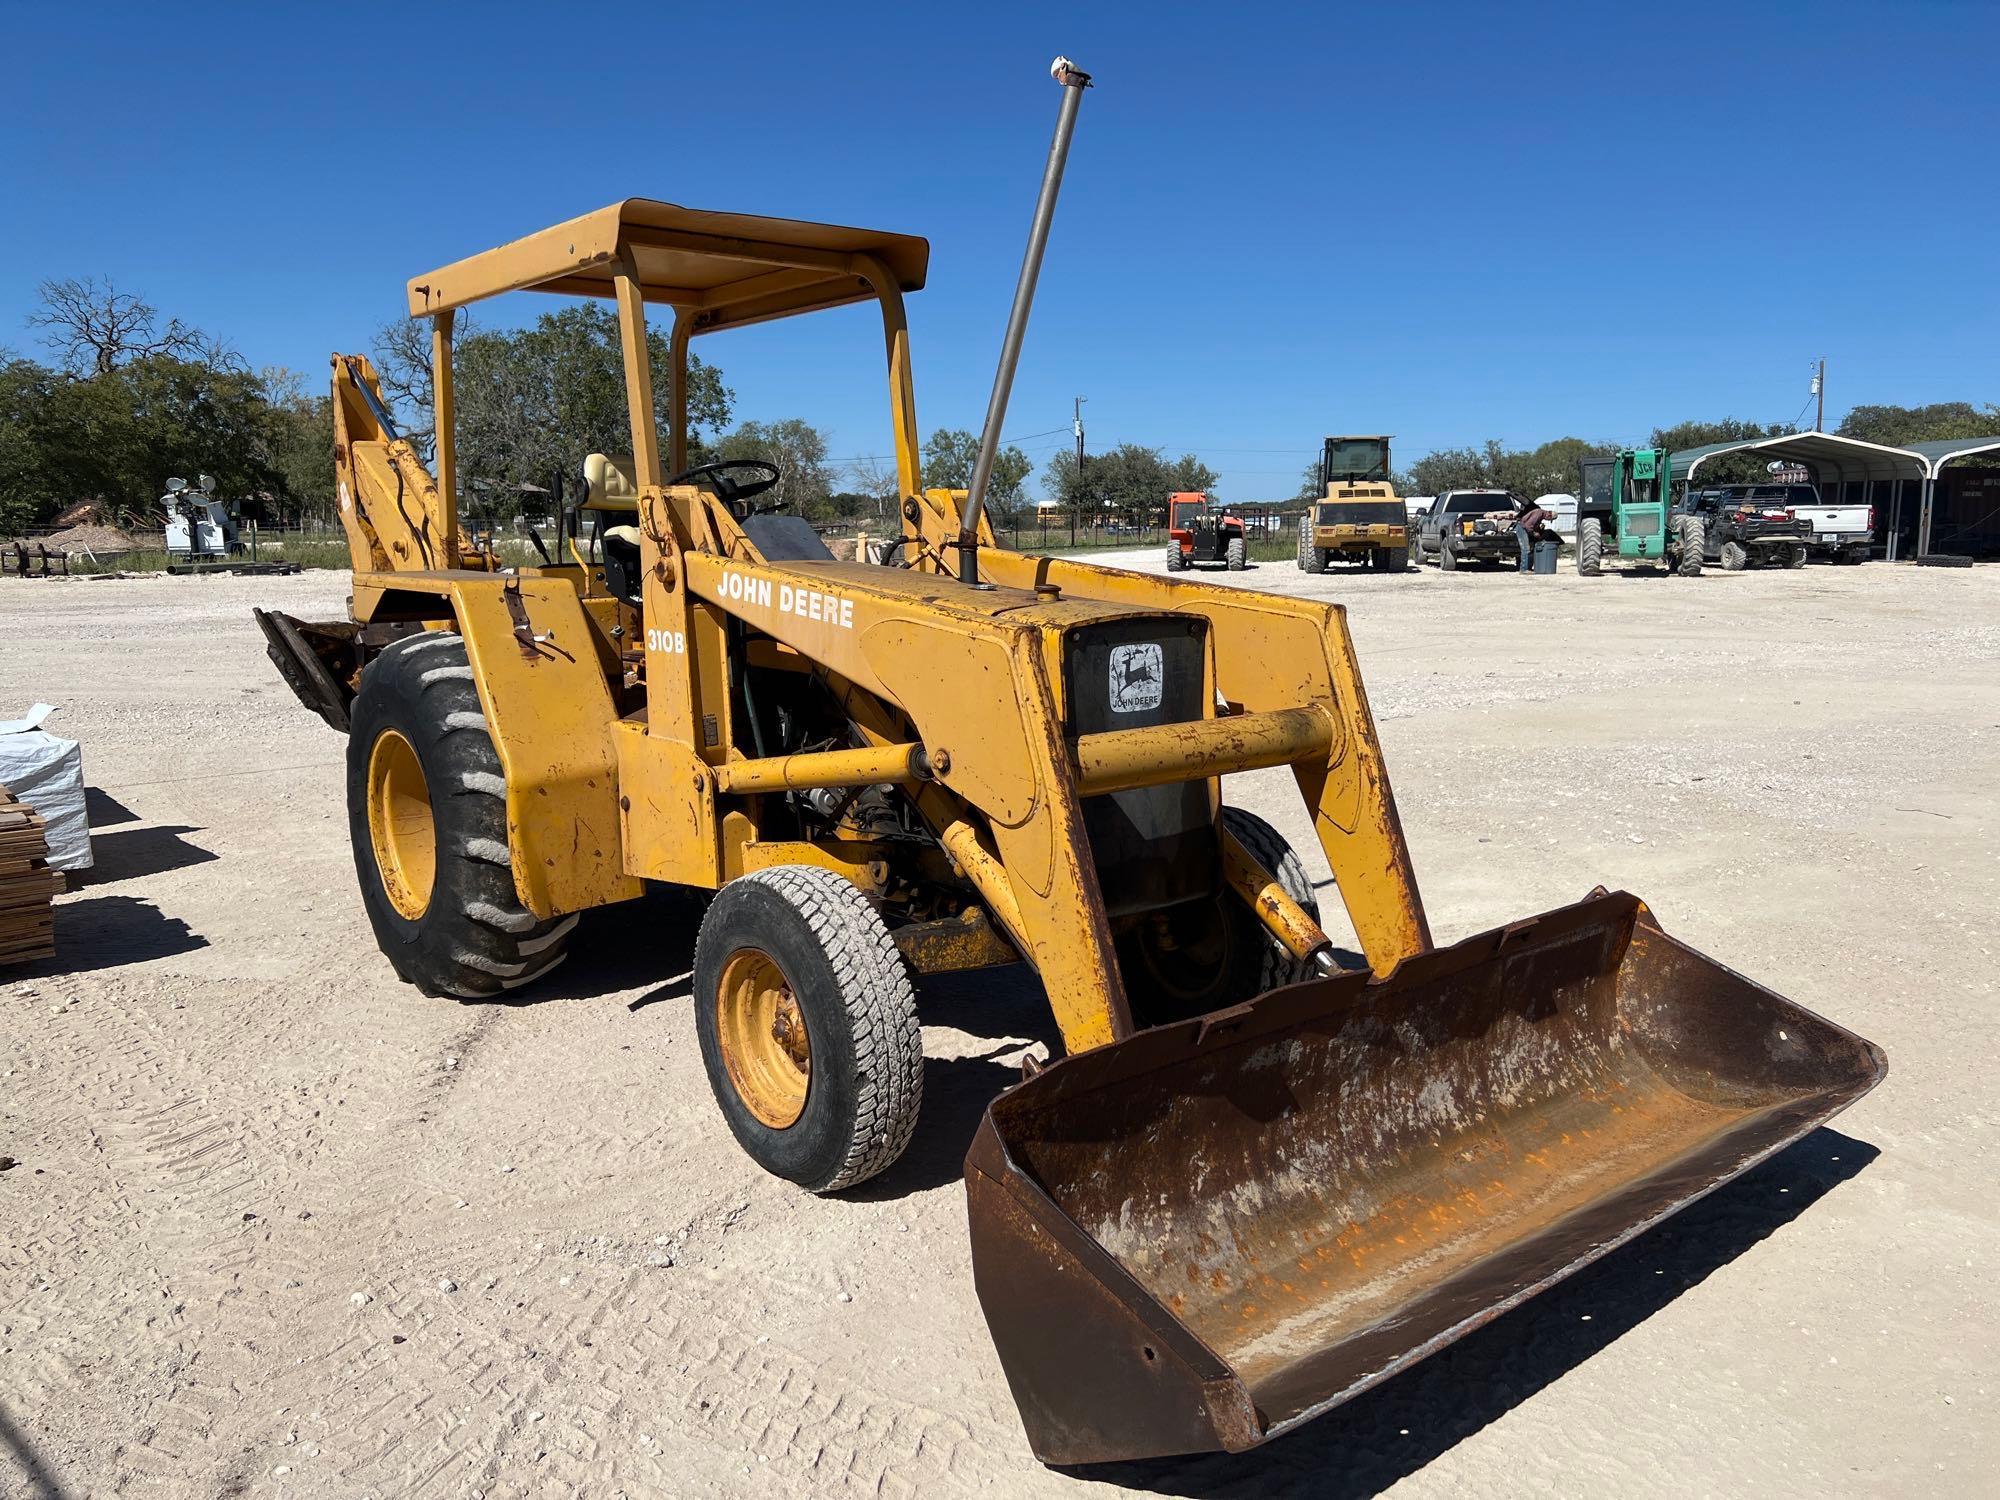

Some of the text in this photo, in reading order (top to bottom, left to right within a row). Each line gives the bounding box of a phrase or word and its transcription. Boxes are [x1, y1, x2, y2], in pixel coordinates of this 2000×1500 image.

[717, 571, 854, 629] JOHN DEERE
[648, 629, 685, 654] 310B
[1113, 695, 1158, 708] JOHN DEERE
